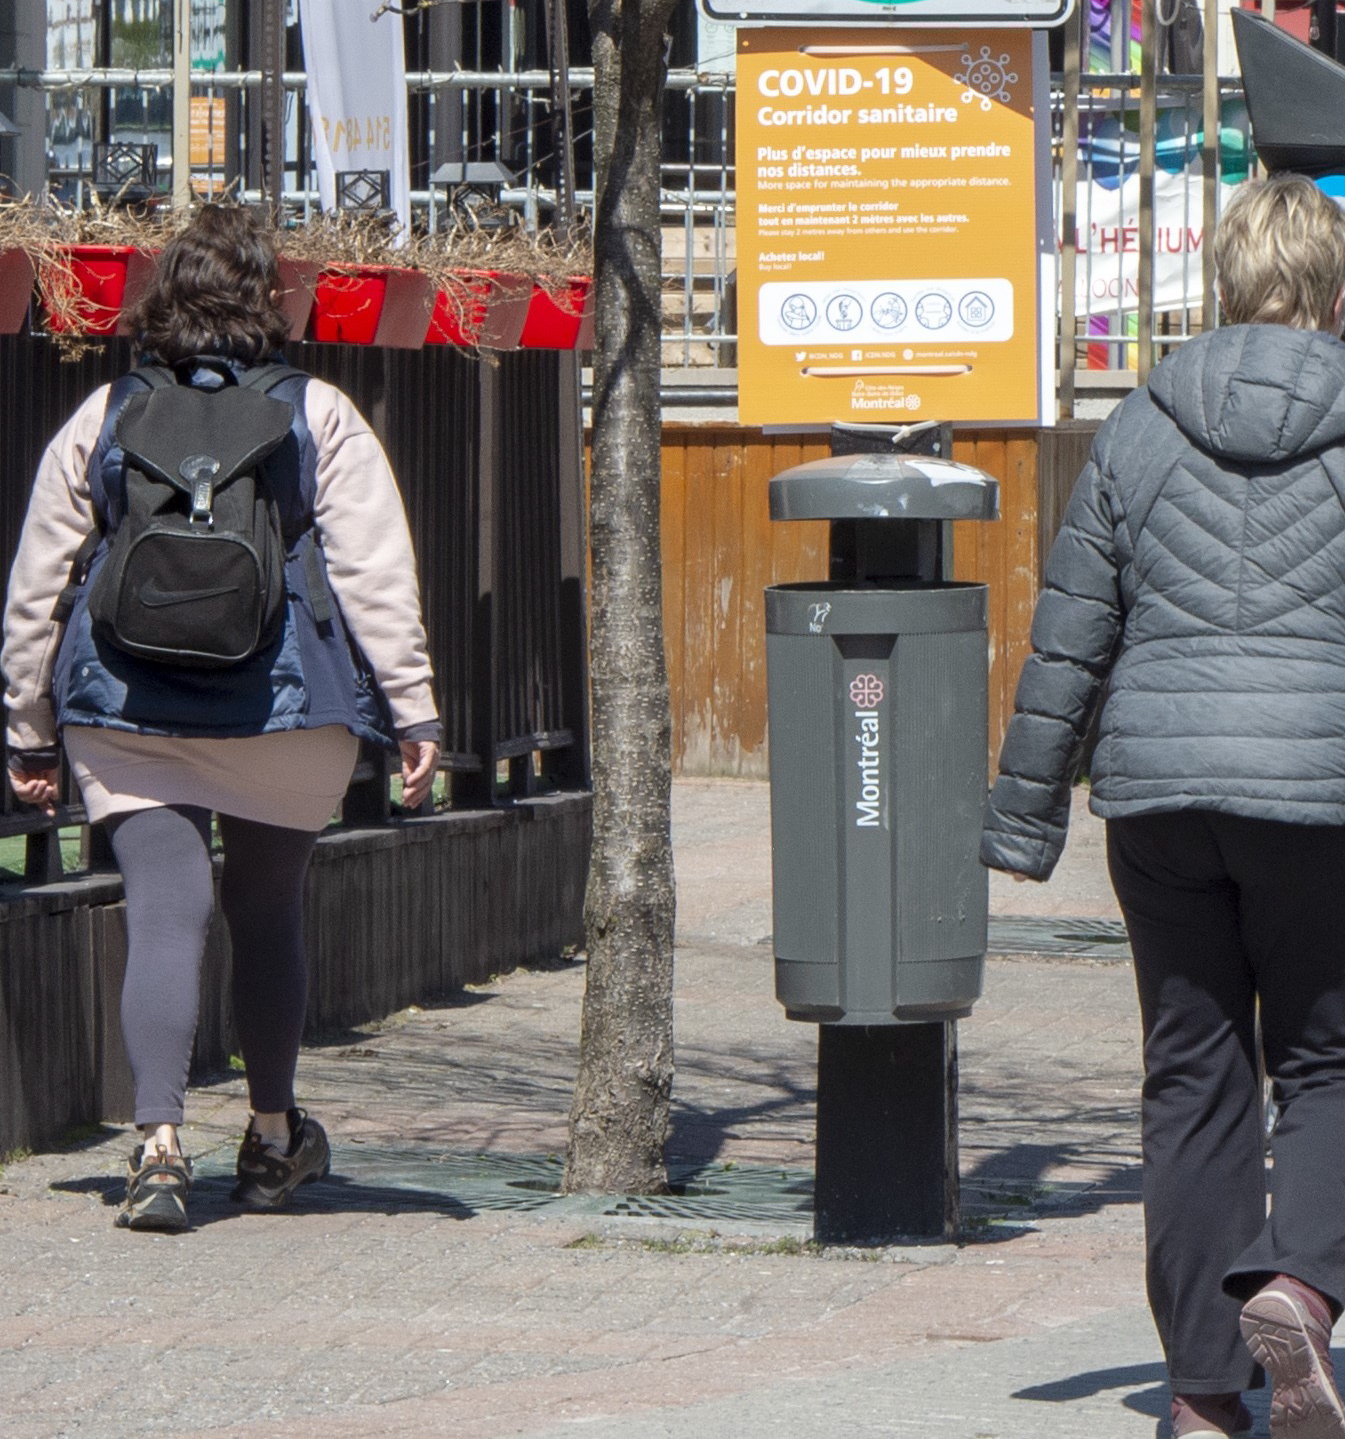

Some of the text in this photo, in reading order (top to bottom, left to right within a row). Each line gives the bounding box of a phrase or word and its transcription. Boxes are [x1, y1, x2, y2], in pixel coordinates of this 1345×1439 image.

[757, 66, 914, 98] COVID-19
[757, 103, 958, 126] Corridor sanitaire
[757, 142, 1011, 163] Plus d'espace pour mieux prendre
[757, 163, 862, 178] nos distances.
[757, 176, 1012, 192] More space for maintaining the appropriate distance.
[758, 201, 899, 215] Merci d'emprunter le corridor
[758, 213, 970, 227] tout en maintenant 2 mètres avec les autres.
[1074, 218, 1205, 254] L'HÉIUM
[758, 251, 825, 262] Achetez local!
[851, 397, 905, 410] Montréal
[855, 711, 880, 827] Montréal
